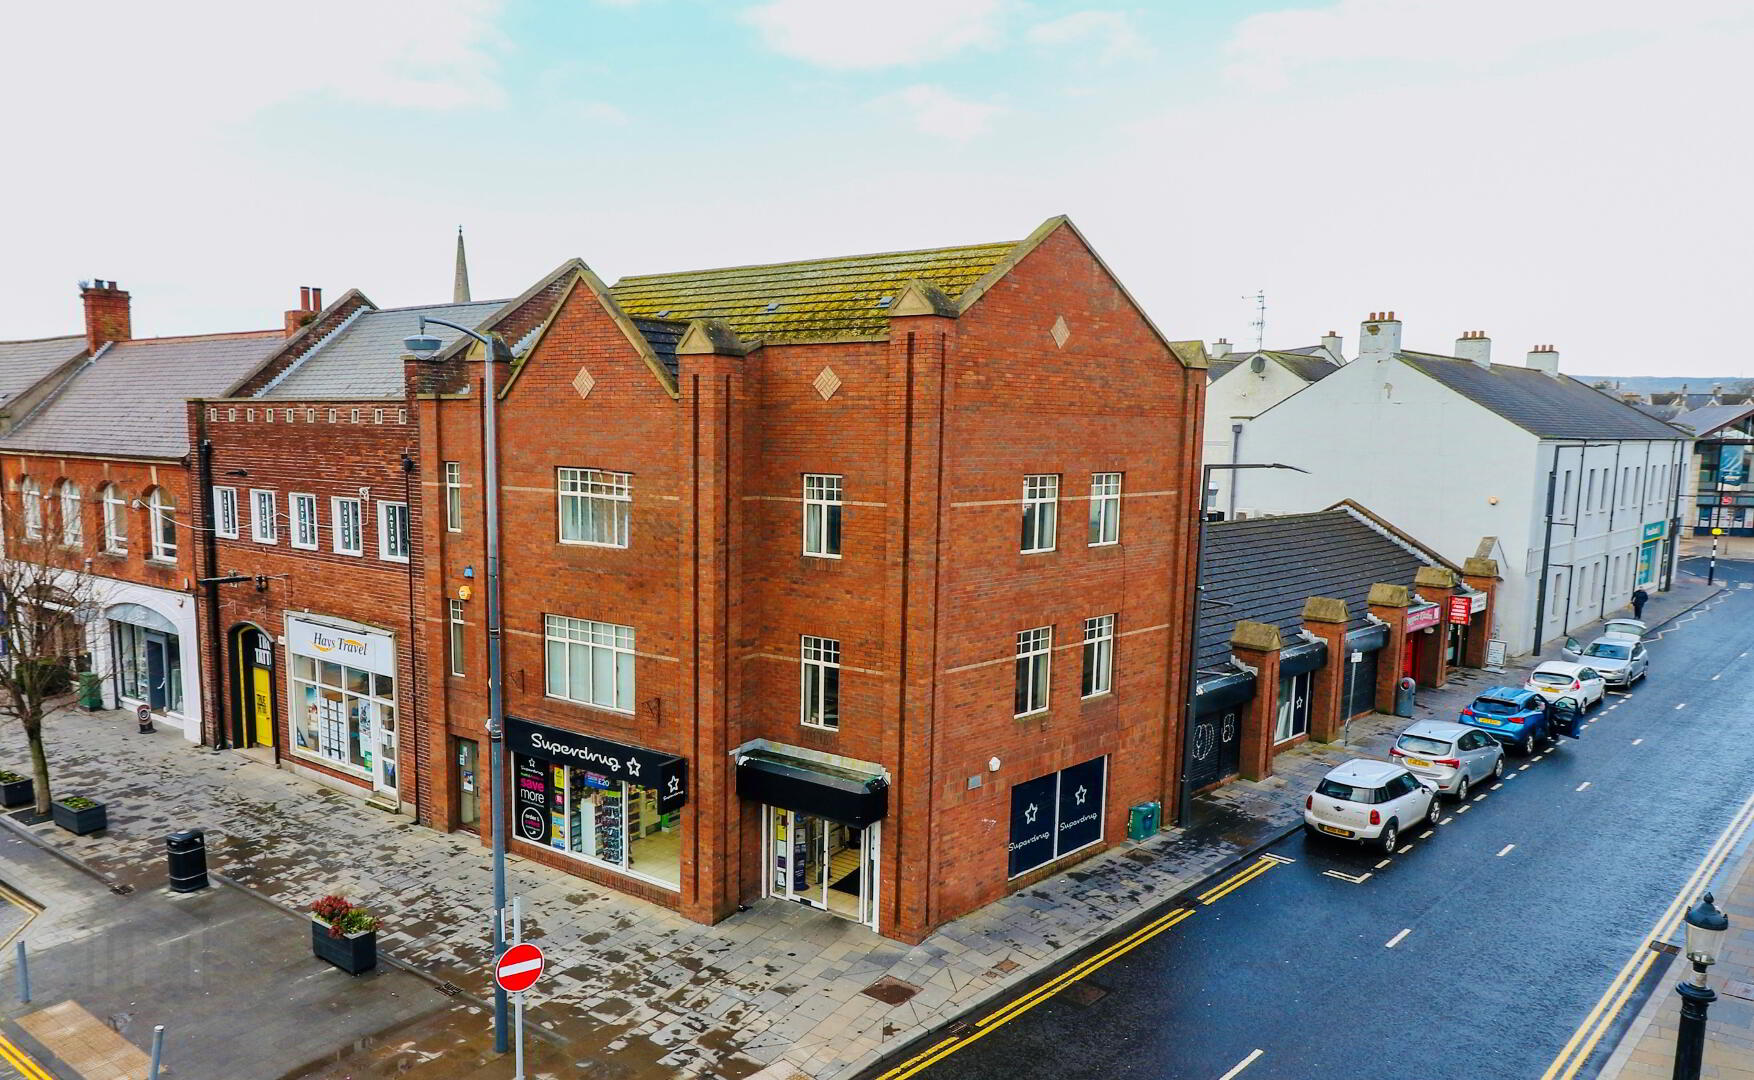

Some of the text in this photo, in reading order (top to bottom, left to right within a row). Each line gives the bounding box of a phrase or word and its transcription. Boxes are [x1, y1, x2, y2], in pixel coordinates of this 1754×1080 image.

[388, 507, 396, 550] TATTOO
[314, 632, 368, 656] Hays Travel
[531, 733, 621, 772] Superdrug
[520, 777, 545, 793] save
[520, 788, 545, 804] more
[662, 790, 684, 801] Superdrug
[1059, 812, 1098, 831] Superdrug
[1008, 831, 1050, 852] Superdrug
